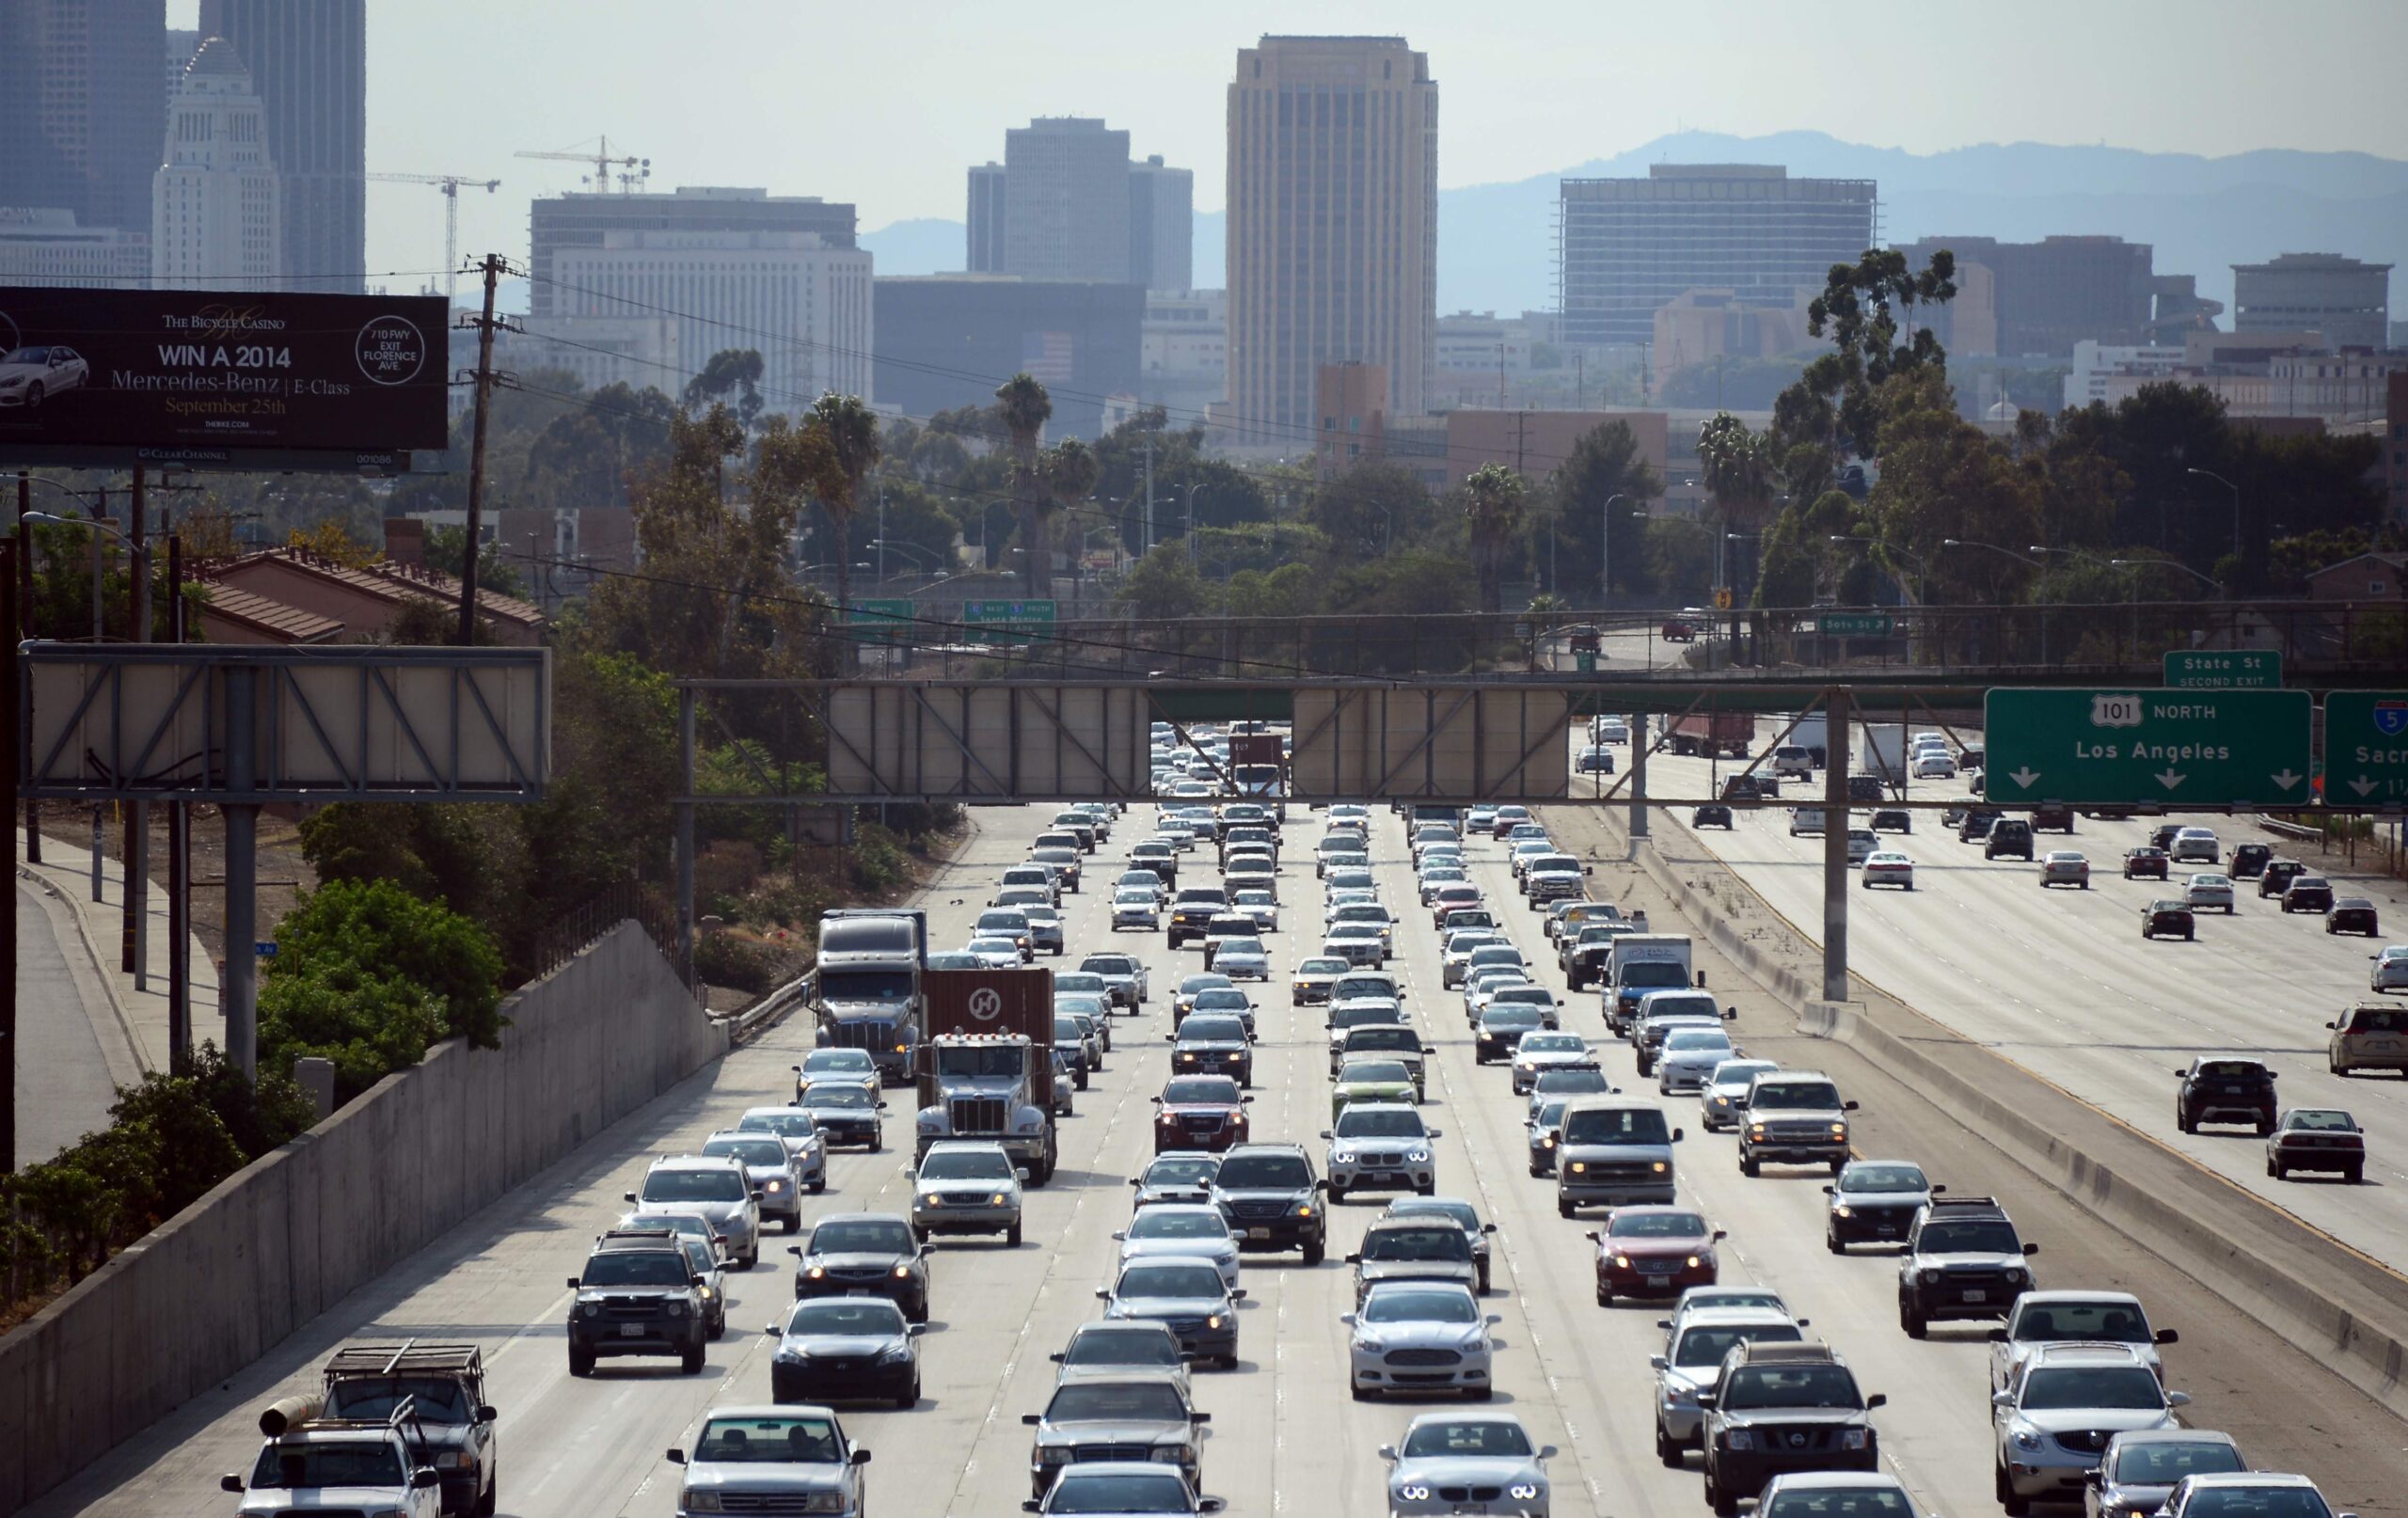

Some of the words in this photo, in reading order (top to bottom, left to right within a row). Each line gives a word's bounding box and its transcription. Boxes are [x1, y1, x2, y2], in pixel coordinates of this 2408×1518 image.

[162, 314, 188, 328] THE
[191, 315, 237, 329] BICYCLE
[240, 317, 286, 330] CASINO
[371, 330, 388, 340] 710
[390, 330, 410, 340] FWY
[380, 341, 401, 352] EXIT
[157, 344, 206, 367] WIN
[211, 346, 231, 367] A
[236, 346, 292, 368] 2014
[363, 351, 417, 361] FLORENCE
[378, 361, 401, 371] AVE.
[112, 370, 279, 393] Mercedes-Benz
[293, 379, 351, 395] E-Class
[166, 397, 248, 417] September
[251, 398, 286, 415] 25th
[356, 454, 392, 465] 001086
[2184, 658, 2230, 670] State
[2243, 657, 2261, 669] St
[2179, 677, 2230, 687] SECOND
[2237, 677, 2264, 686] EXIT
[2102, 703, 2131, 719] 101
[2154, 705, 2216, 719] NORTH
[2387, 711, 2398, 728] 5
[2077, 741, 2117, 759] Los
[2131, 741, 2229, 764] Angeles
